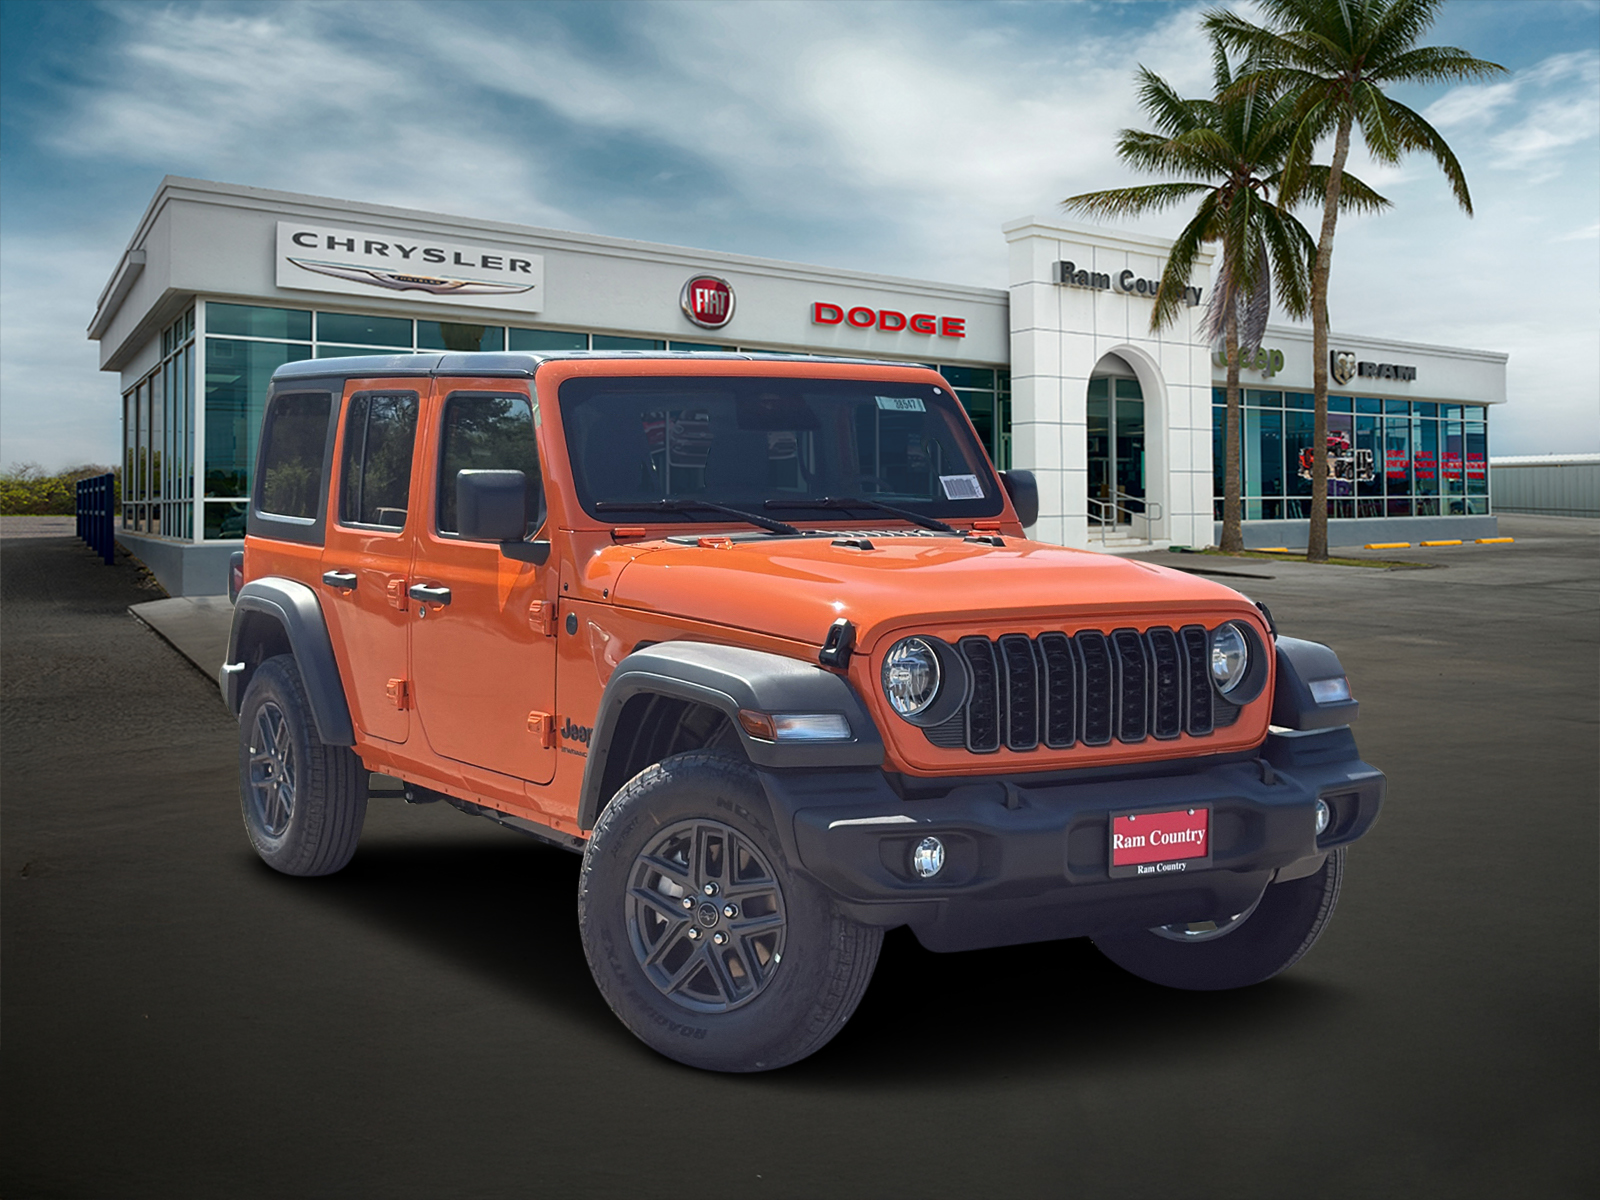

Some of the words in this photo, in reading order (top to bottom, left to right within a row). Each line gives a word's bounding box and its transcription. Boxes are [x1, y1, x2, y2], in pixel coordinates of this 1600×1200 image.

[291, 231, 533, 274] CHRYSLER
[1057, 260, 1111, 290] Ram
[1117, 269, 1203, 306] Coury
[695, 287, 728, 316] FIAT
[812, 301, 966, 338] DODGE
[1358, 361, 1417, 381] RAM
[1113, 833, 1145, 850] Ram
[1150, 828, 1206, 845] Country
[1137, 864, 1155, 875] Ram
[1156, 861, 1187, 873] Country
